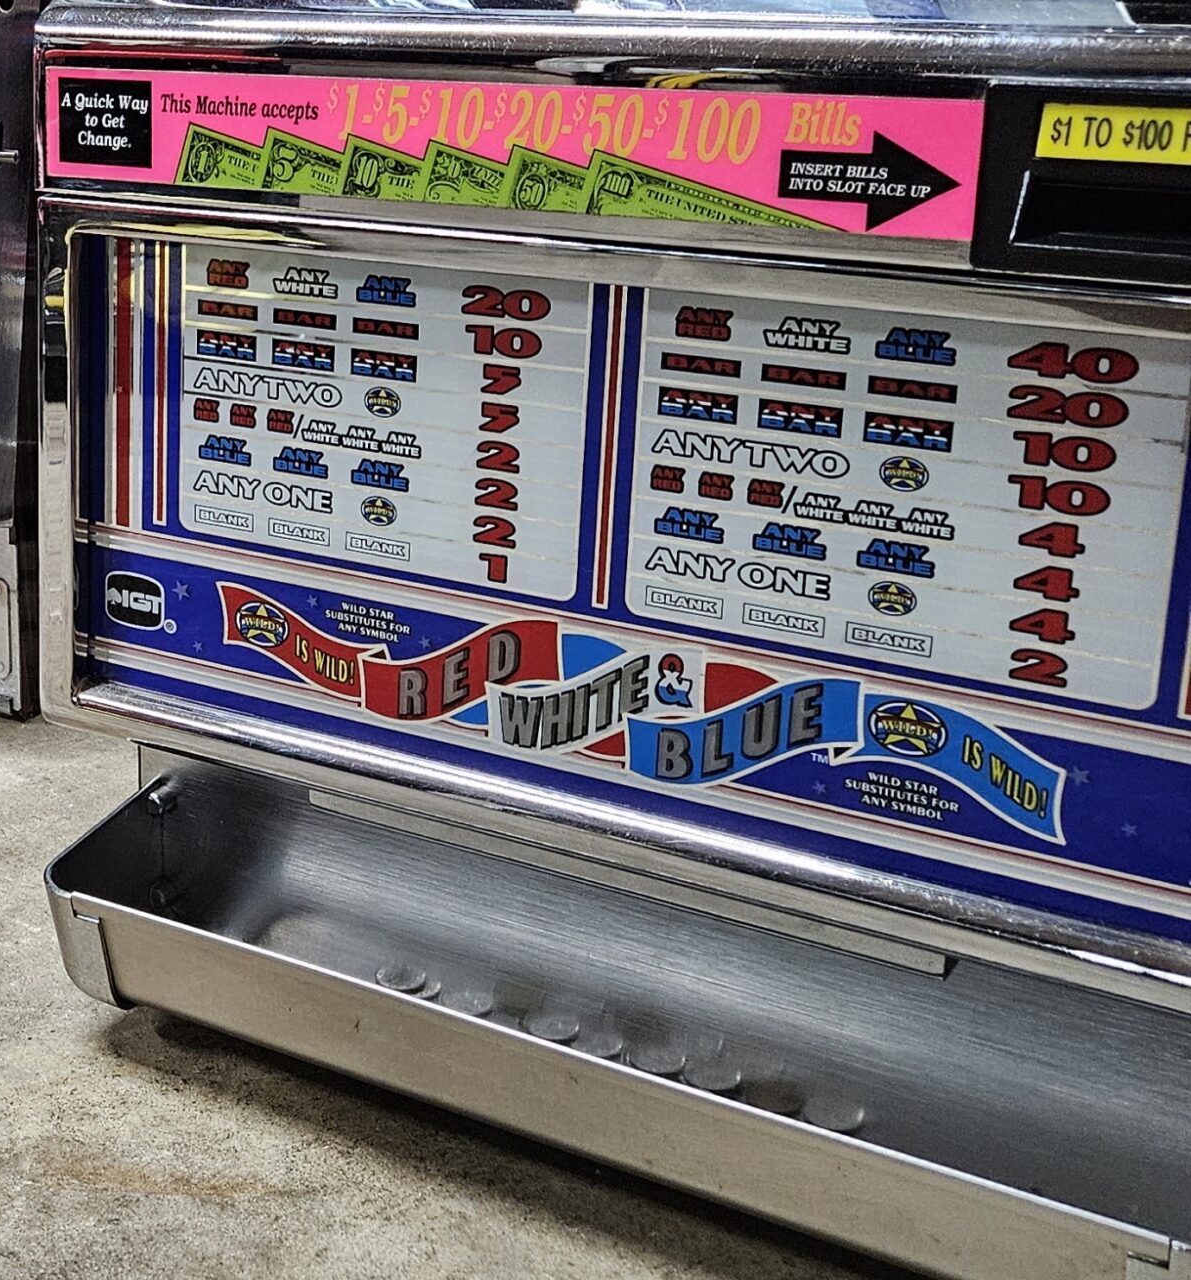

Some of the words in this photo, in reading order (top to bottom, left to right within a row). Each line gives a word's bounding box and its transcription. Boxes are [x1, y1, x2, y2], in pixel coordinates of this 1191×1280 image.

[61, 94, 72, 110] A
[75, 93, 115, 111] Quick
[118, 94, 149, 116] Way
[84, 113, 99, 127] to
[101, 113, 125, 129] Get
[160, 93, 192, 115] This
[195, 95, 258, 119] Machine
[261, 101, 320, 126] accepts
[783, 101, 863, 148] Bills
[77, 130, 133, 150] Change.
[1050, 115, 1073, 146] $1
[1084, 116, 1113, 148] TO
[1122, 118, 1174, 152] $100
[788, 178, 824, 192] INTO
[826, 179, 866, 195] SLOT
[868, 181, 909, 198] FACE
[911, 184, 932, 200] UP
[789, 162, 843, 178] INSERT
[846, 164, 889, 180] BILLS
[461, 285, 552, 322] 20
[464, 325, 543, 360] 10
[1007, 341, 1140, 385] 40
[1007, 384, 1129, 430] 20
[1013, 431, 1117, 473] 10
[193, 470, 261, 501] ANY
[263, 481, 333, 515] ONE
[645, 547, 735, 583] ANY
[738, 561, 831, 602] ONE
[120, 590, 163, 617] IGT
[341, 601, 367, 616] WILD
[368, 606, 395, 621] STAR
[325, 608, 389, 631] SUBSTITUTES
[389, 621, 411, 636] FOR
[337, 622, 359, 636] ANY
[361, 626, 401, 644] SYMBOL
[295, 634, 309, 663] IS
[313, 648, 356, 686] WILD!
[398, 628, 521, 719] RED
[499, 654, 651, 751] WHITE
[655, 652, 693, 708] &
[655, 684, 825, 780] BLUE
[866, 770, 901, 788] WILD
[904, 778, 939, 796] STAR
[961, 735, 984, 771] IS
[989, 753, 1049, 820] WILD!
[844, 778, 927, 808] SUBSTITUTES
[930, 796, 960, 814] FOR
[860, 793, 889, 810] ANY
[891, 800, 944, 822] SYMBOL
